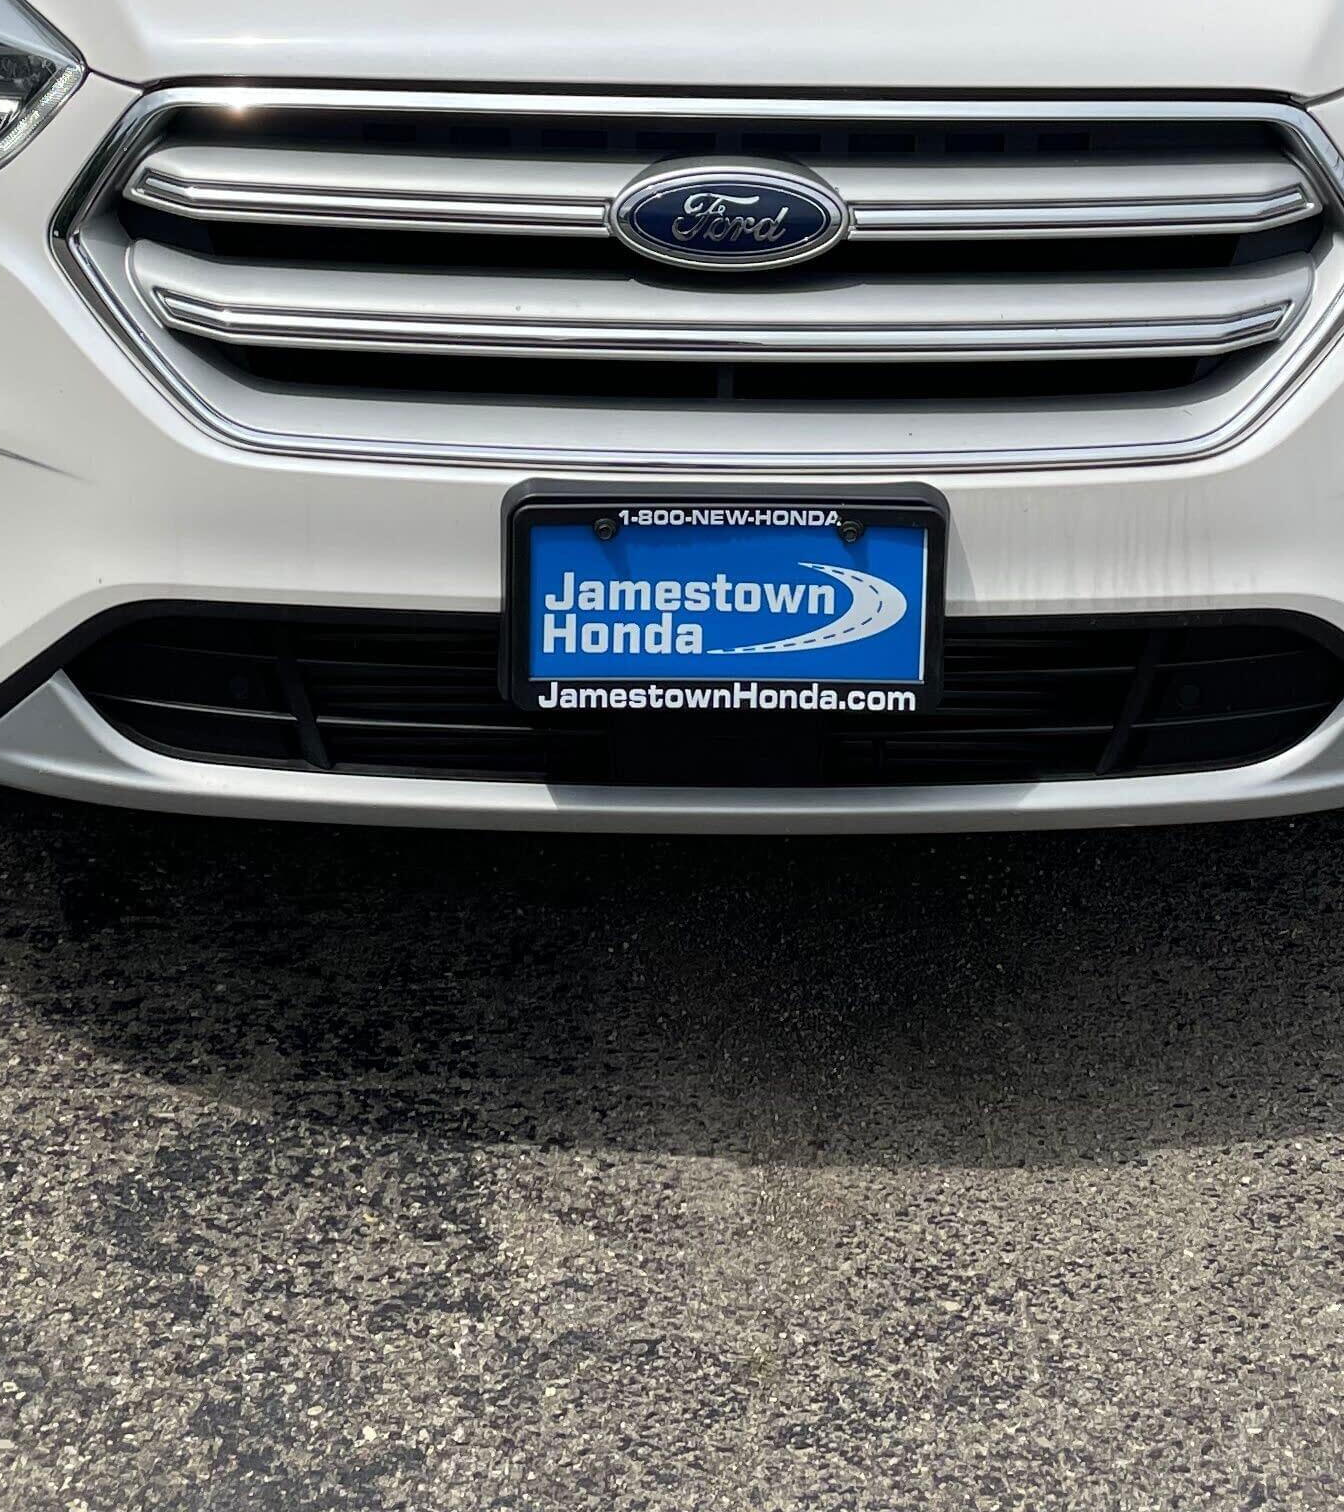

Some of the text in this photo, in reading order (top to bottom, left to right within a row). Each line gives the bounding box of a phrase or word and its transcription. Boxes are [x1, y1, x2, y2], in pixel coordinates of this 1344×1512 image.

[671, 192, 790, 242] Ford
[618, 509, 842, 527] 1-800-NEW-HONDA
[544, 571, 836, 616] Jamestown
[542, 612, 704, 655] Honda
[538, 681, 917, 712] JamestownHonda.com
